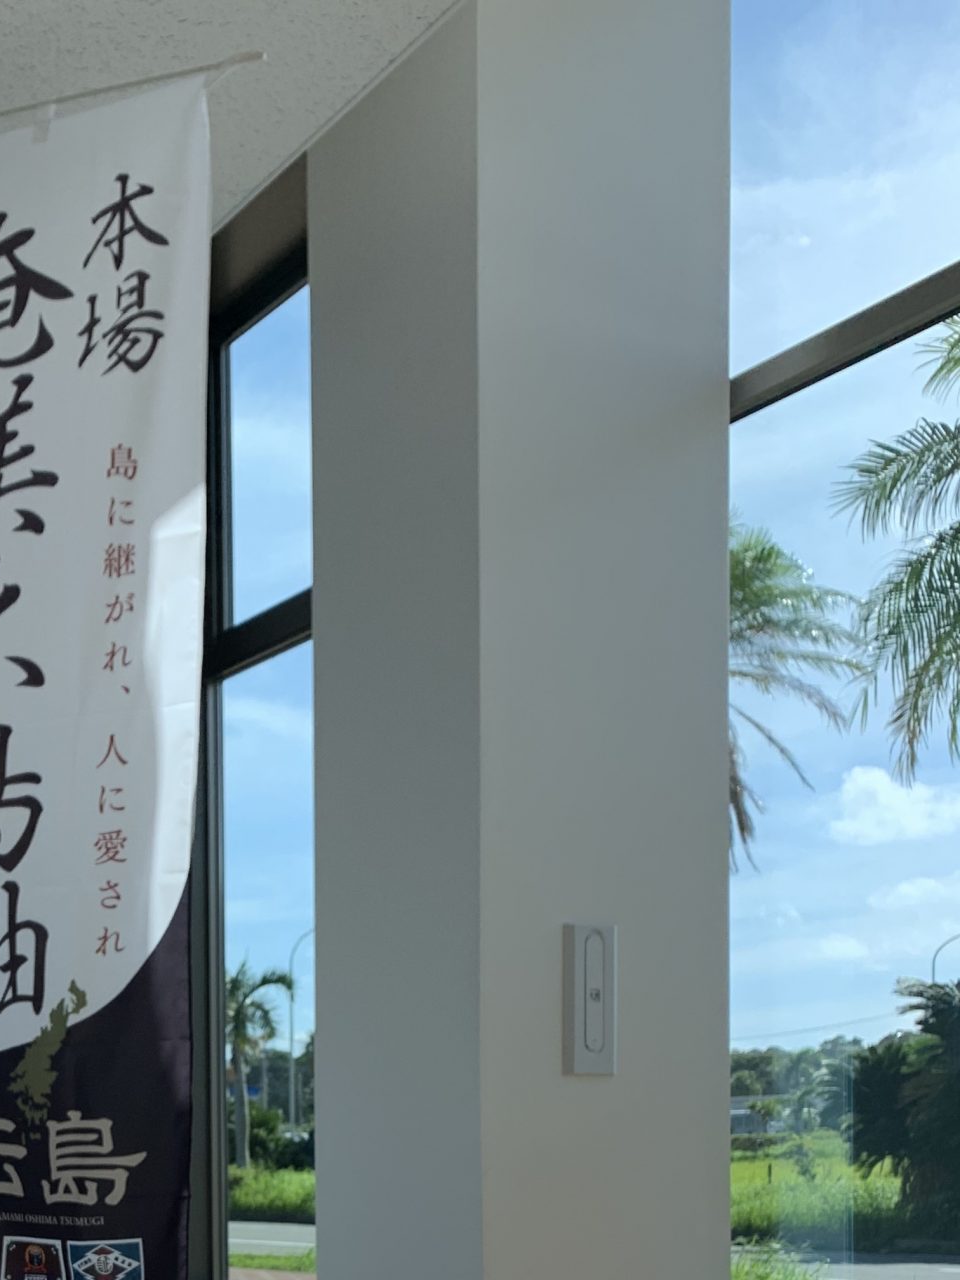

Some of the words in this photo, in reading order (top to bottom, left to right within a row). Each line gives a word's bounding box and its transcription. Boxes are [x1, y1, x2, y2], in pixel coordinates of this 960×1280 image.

[77, 173, 169, 377] 本場
[25, 1214, 58, 1225] OSHIMA
[60, 1215, 105, 1227] TSUMUGI
